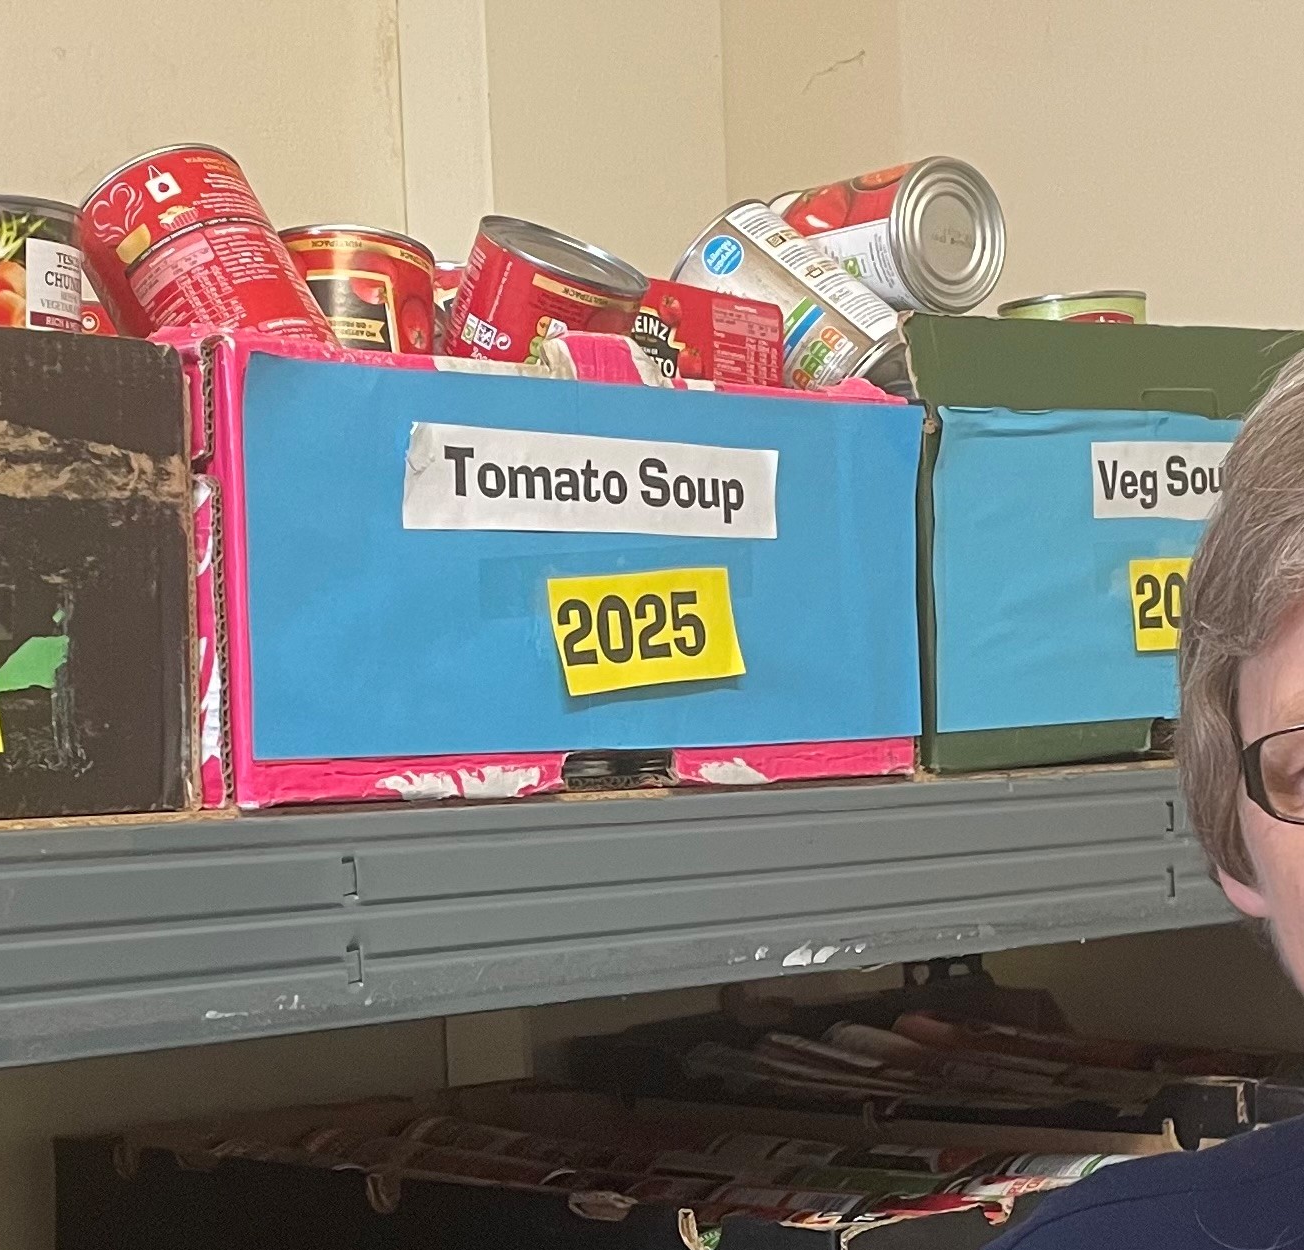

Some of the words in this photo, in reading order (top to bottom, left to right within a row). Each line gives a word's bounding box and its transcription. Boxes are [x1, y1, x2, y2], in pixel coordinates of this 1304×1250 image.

[44, 270, 81, 293] CHUN
[632, 315, 668, 341] EINZ
[444, 446, 627, 505] Tomato
[638, 457, 745, 523] Soup
[1098, 459, 1158, 509] Veg
[1165, 455, 1222, 497] Sou
[556, 590, 706, 666] 2025
[1135, 573, 1187, 630] 20
